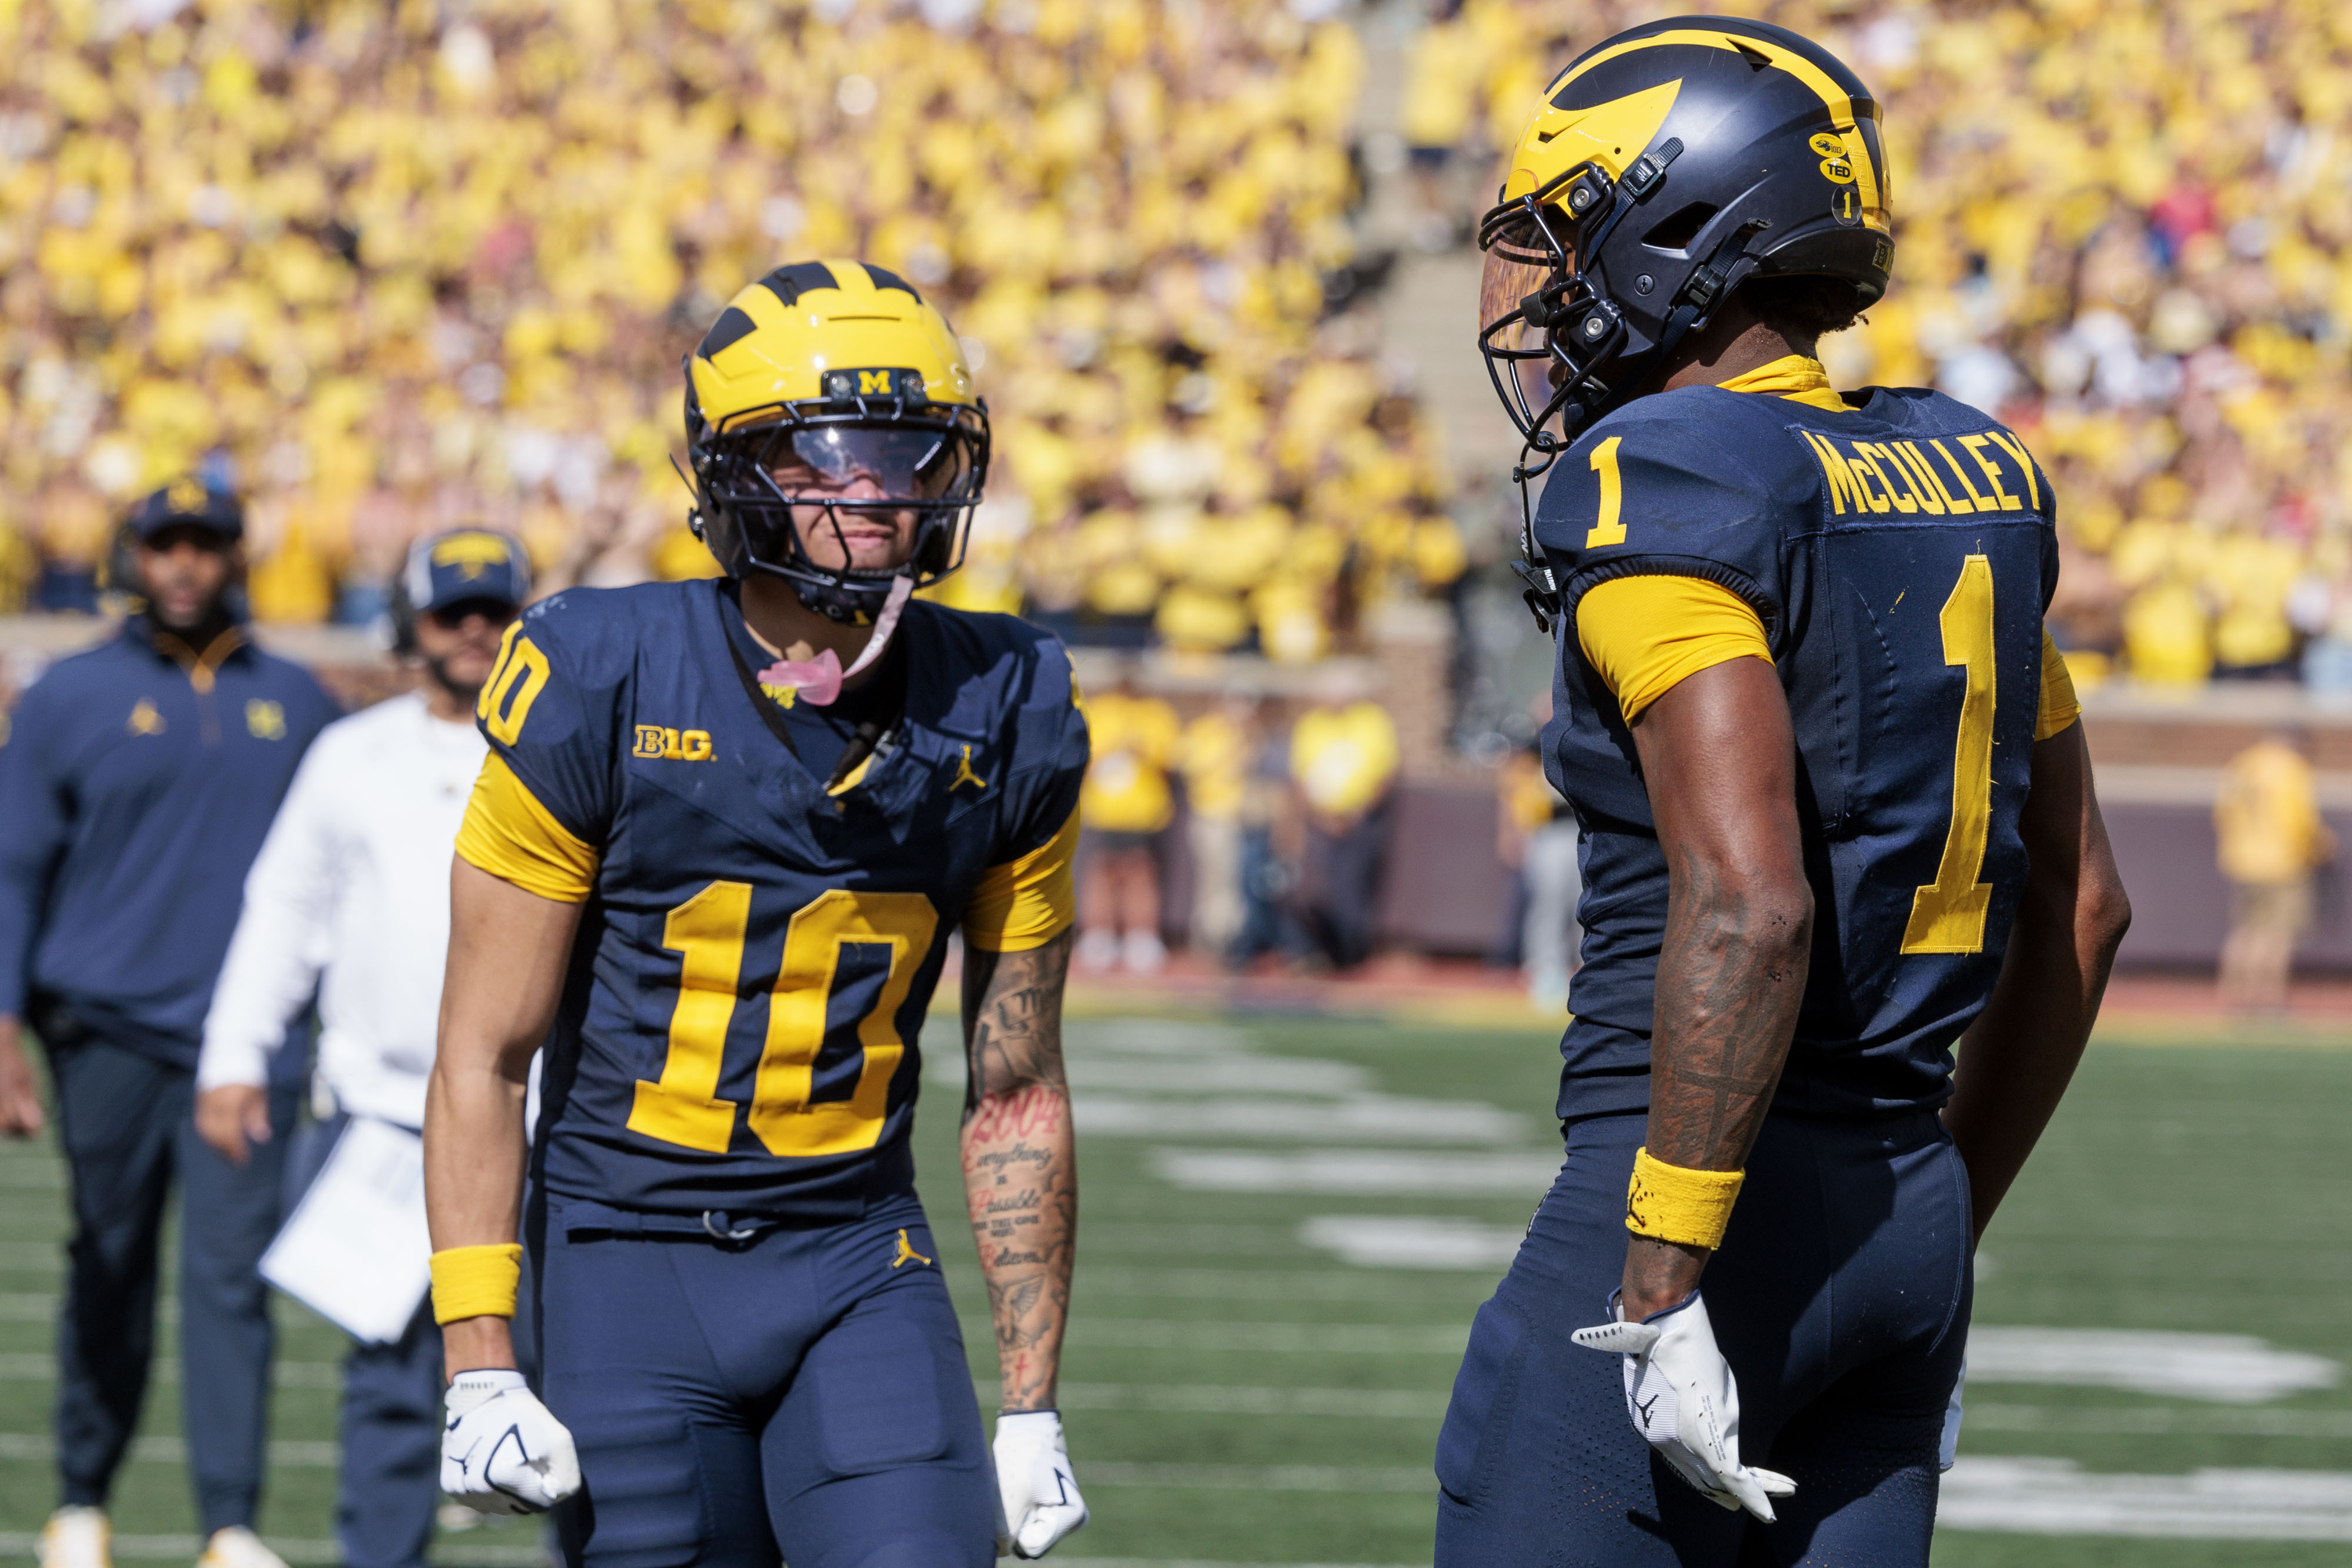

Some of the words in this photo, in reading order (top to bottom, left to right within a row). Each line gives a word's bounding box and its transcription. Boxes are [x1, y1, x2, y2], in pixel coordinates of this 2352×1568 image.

[1827, 163, 1851, 178] TED
[1843, 191, 1852, 219] 1
[858, 369, 892, 395] M
[1585, 435, 1628, 549] 1
[477, 618, 551, 749] 10
[1899, 554, 1997, 955] 1
[626, 879, 940, 1158] 10
[971, 1084, 1062, 1145] 2004
[1579, 1326, 1623, 1341] JORDAN
